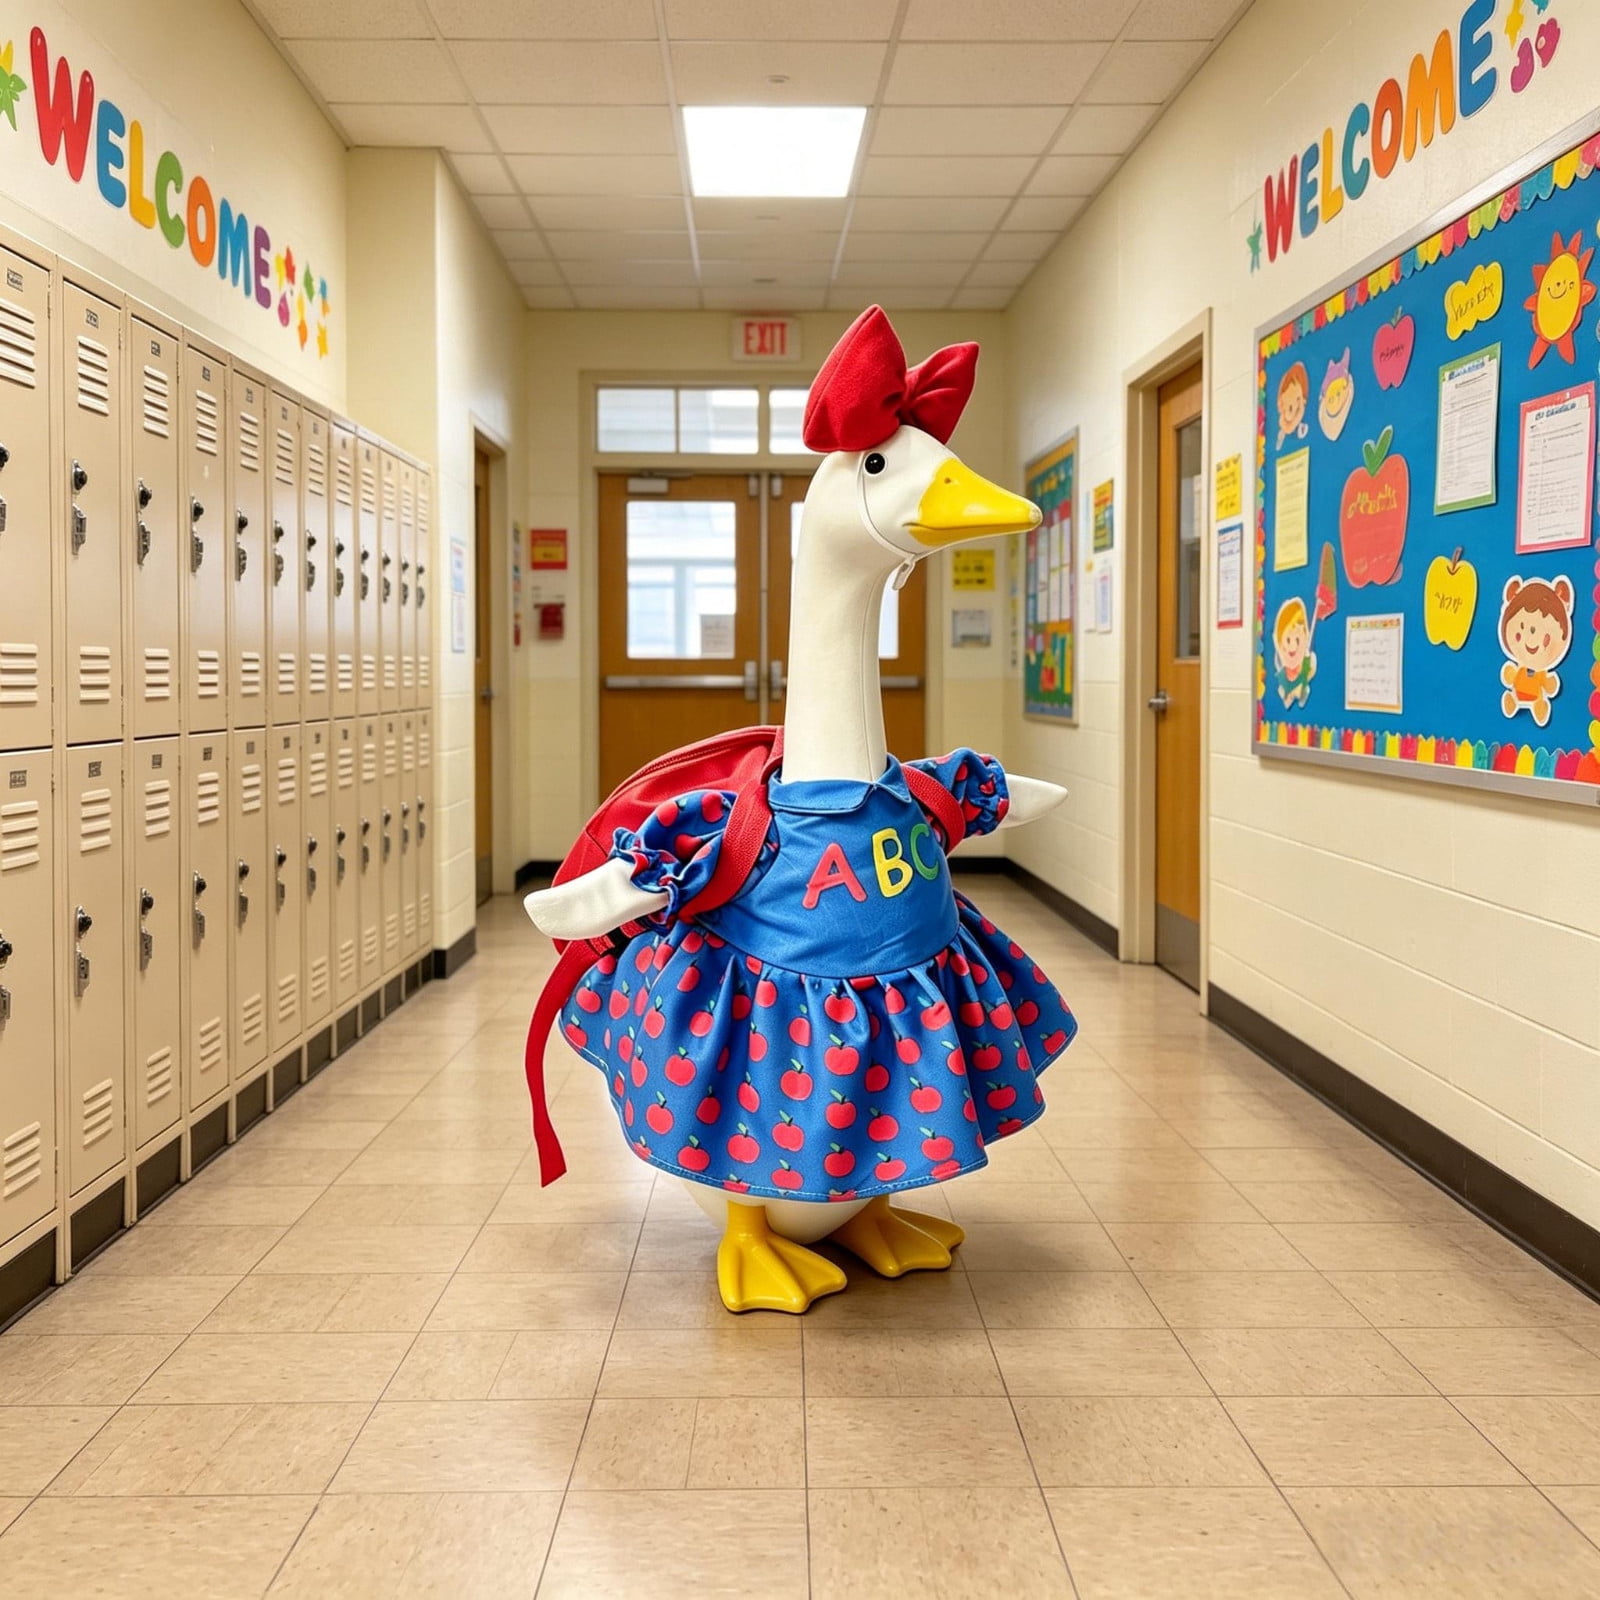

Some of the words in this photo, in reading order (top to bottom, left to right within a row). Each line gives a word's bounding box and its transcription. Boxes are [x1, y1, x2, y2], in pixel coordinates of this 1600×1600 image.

[29, 26, 272, 310] WELCOME
[1263, 0, 1498, 264] WELCOME
[743, 321, 787, 355] EXIT
[802, 823, 940, 910] ABC
